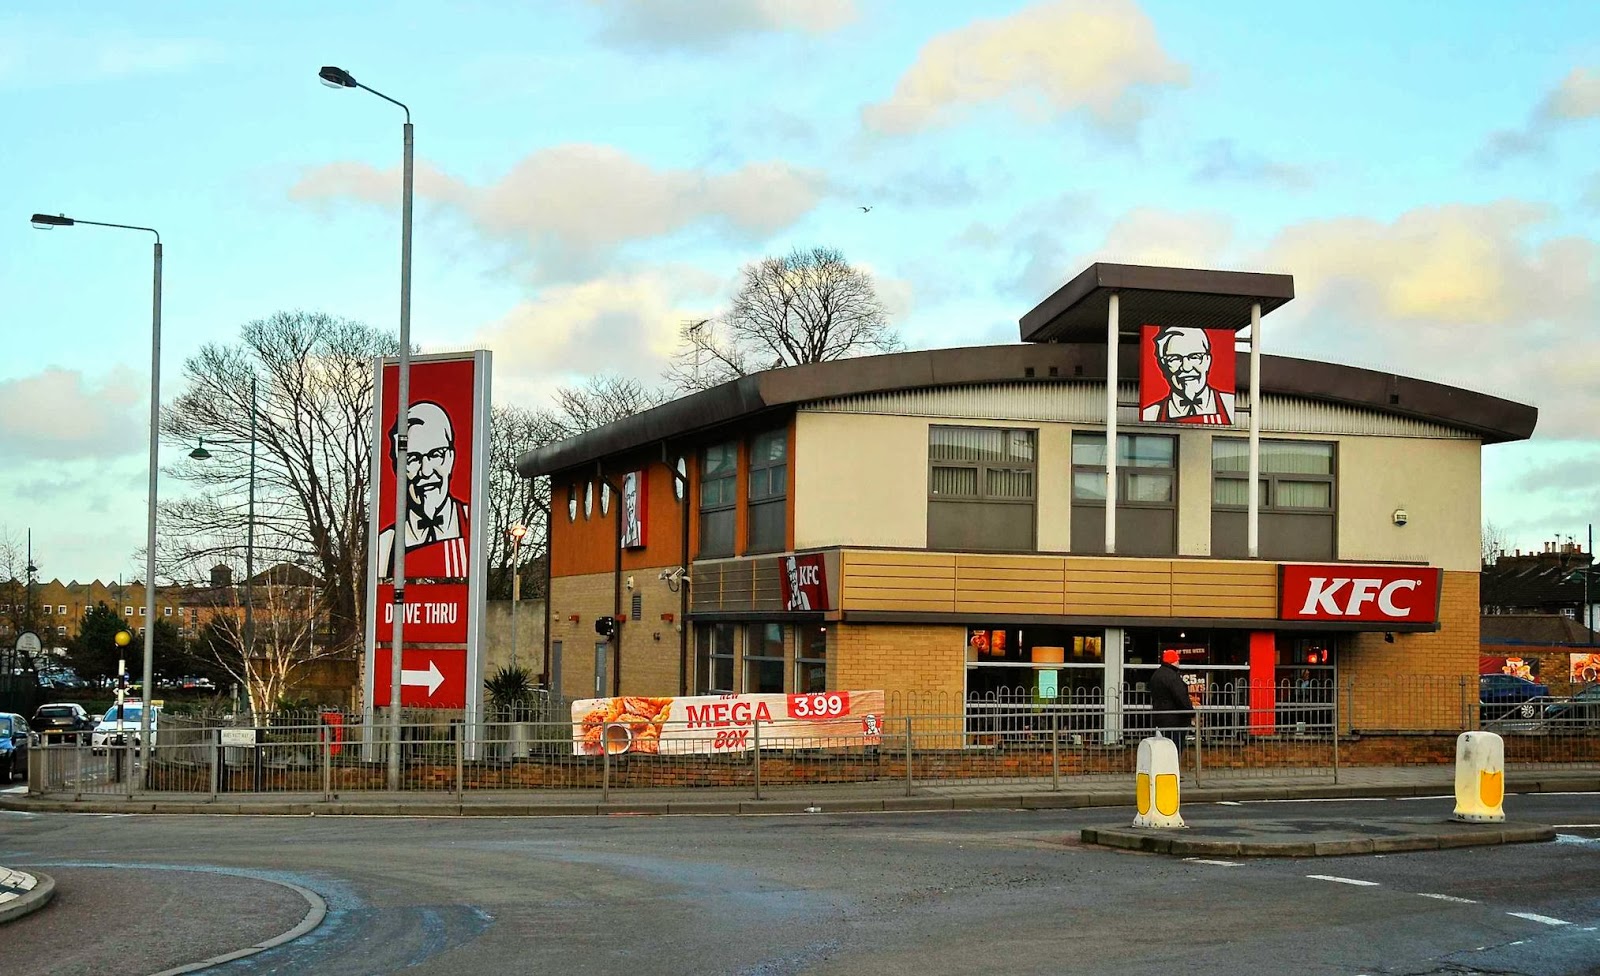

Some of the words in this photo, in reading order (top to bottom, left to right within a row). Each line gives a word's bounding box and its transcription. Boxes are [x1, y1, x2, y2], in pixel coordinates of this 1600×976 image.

[799, 565, 819, 586] KFC
[1299, 577, 1417, 617] KFC
[385, 603, 421, 624] DIVE
[424, 603, 457, 624] THRU
[686, 702, 774, 728] MEGA
[794, 695, 842, 716] 3.99
[714, 730, 749, 749] BOX
